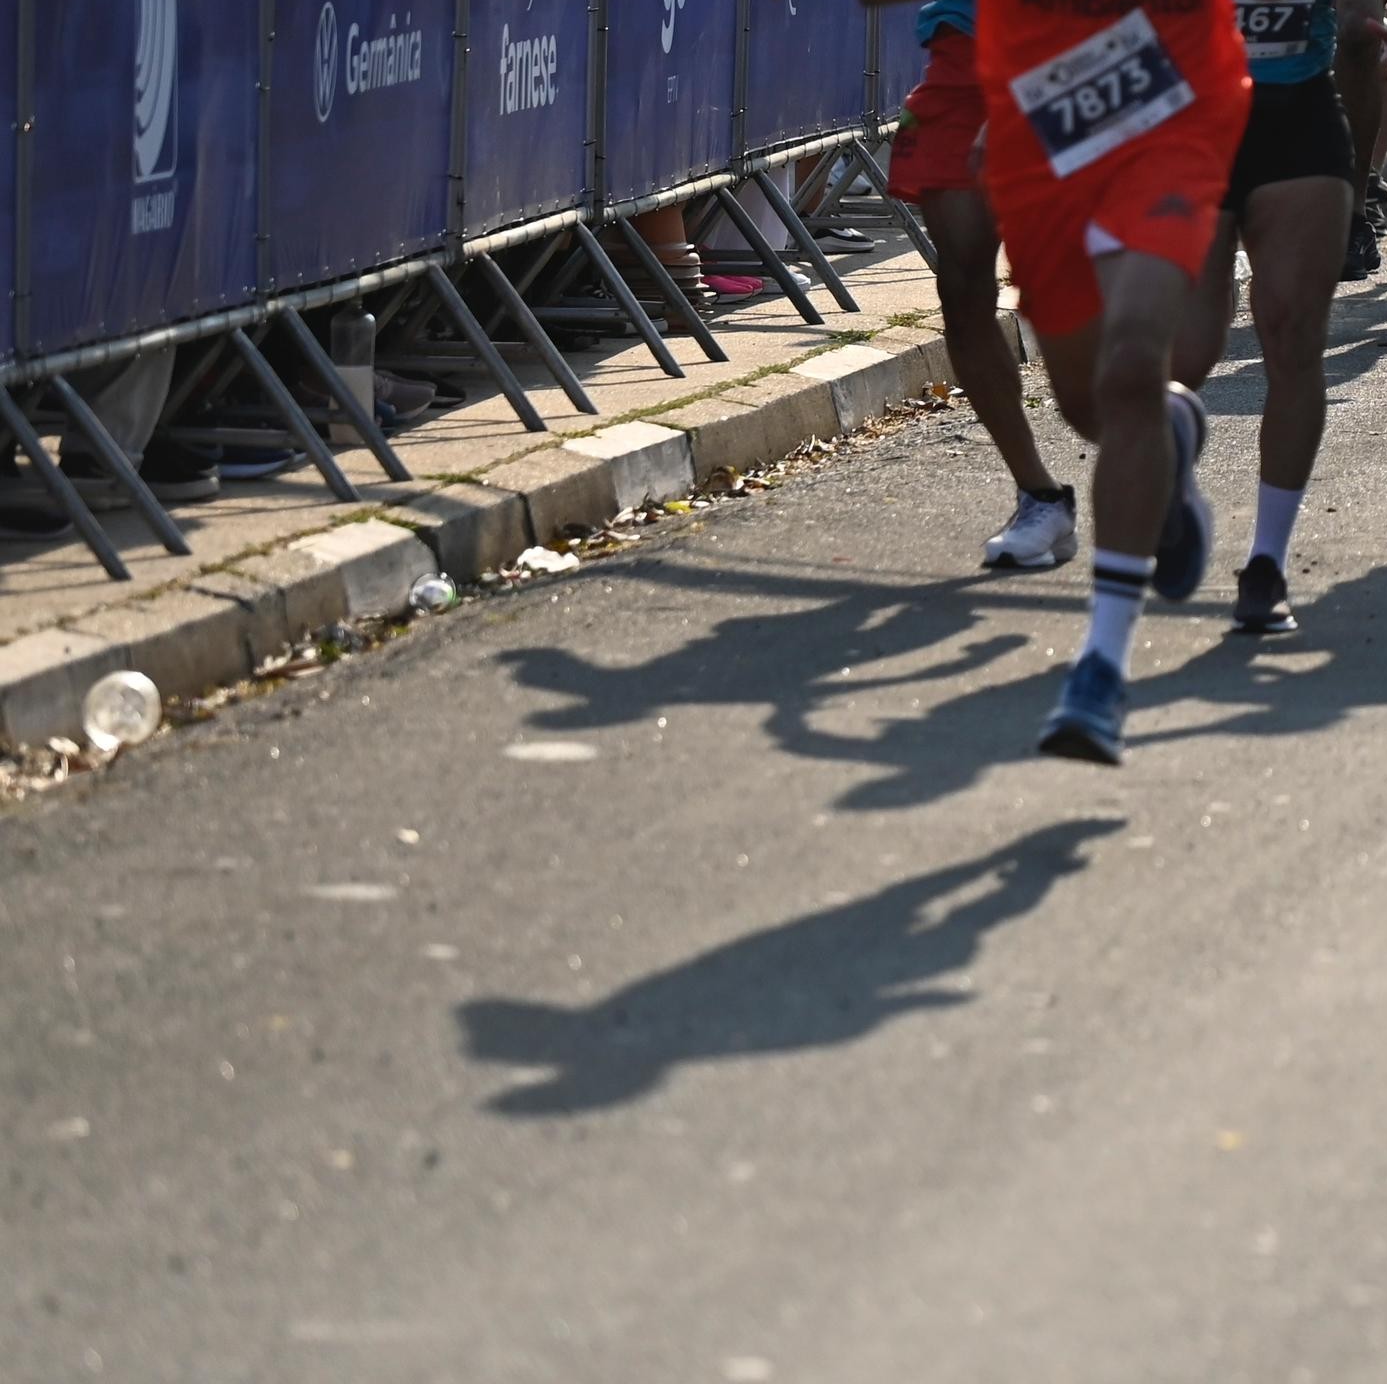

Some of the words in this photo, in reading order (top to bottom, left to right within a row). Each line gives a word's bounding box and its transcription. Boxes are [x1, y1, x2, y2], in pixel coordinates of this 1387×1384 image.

[345, 10, 422, 96] Germânica
[500, 24, 557, 115] farnese
[1050, 56, 1151, 134] 7873
